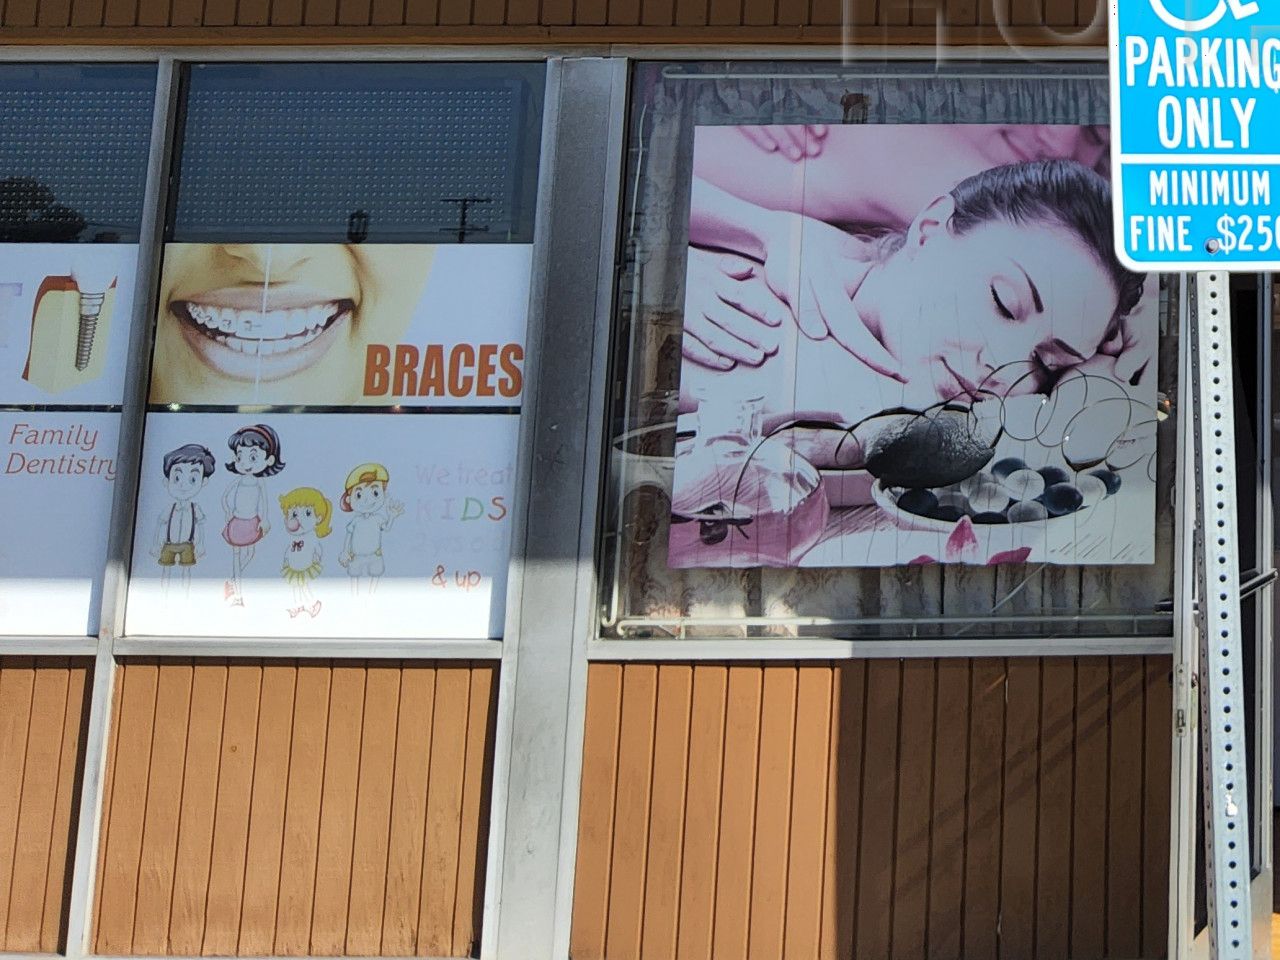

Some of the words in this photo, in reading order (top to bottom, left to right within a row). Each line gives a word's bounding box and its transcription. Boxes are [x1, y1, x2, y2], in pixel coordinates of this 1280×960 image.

[1157, 96, 1256, 150] ONLY
[1148, 169, 1271, 207] MINIMUM
[1130, 215, 1193, 252] FINE
[362, 342, 524, 398] BRACES
[9, 423, 98, 451] Family
[4, 452, 118, 482] Dentistry
[431, 563, 448, 589] &
[454, 569, 482, 593] up
